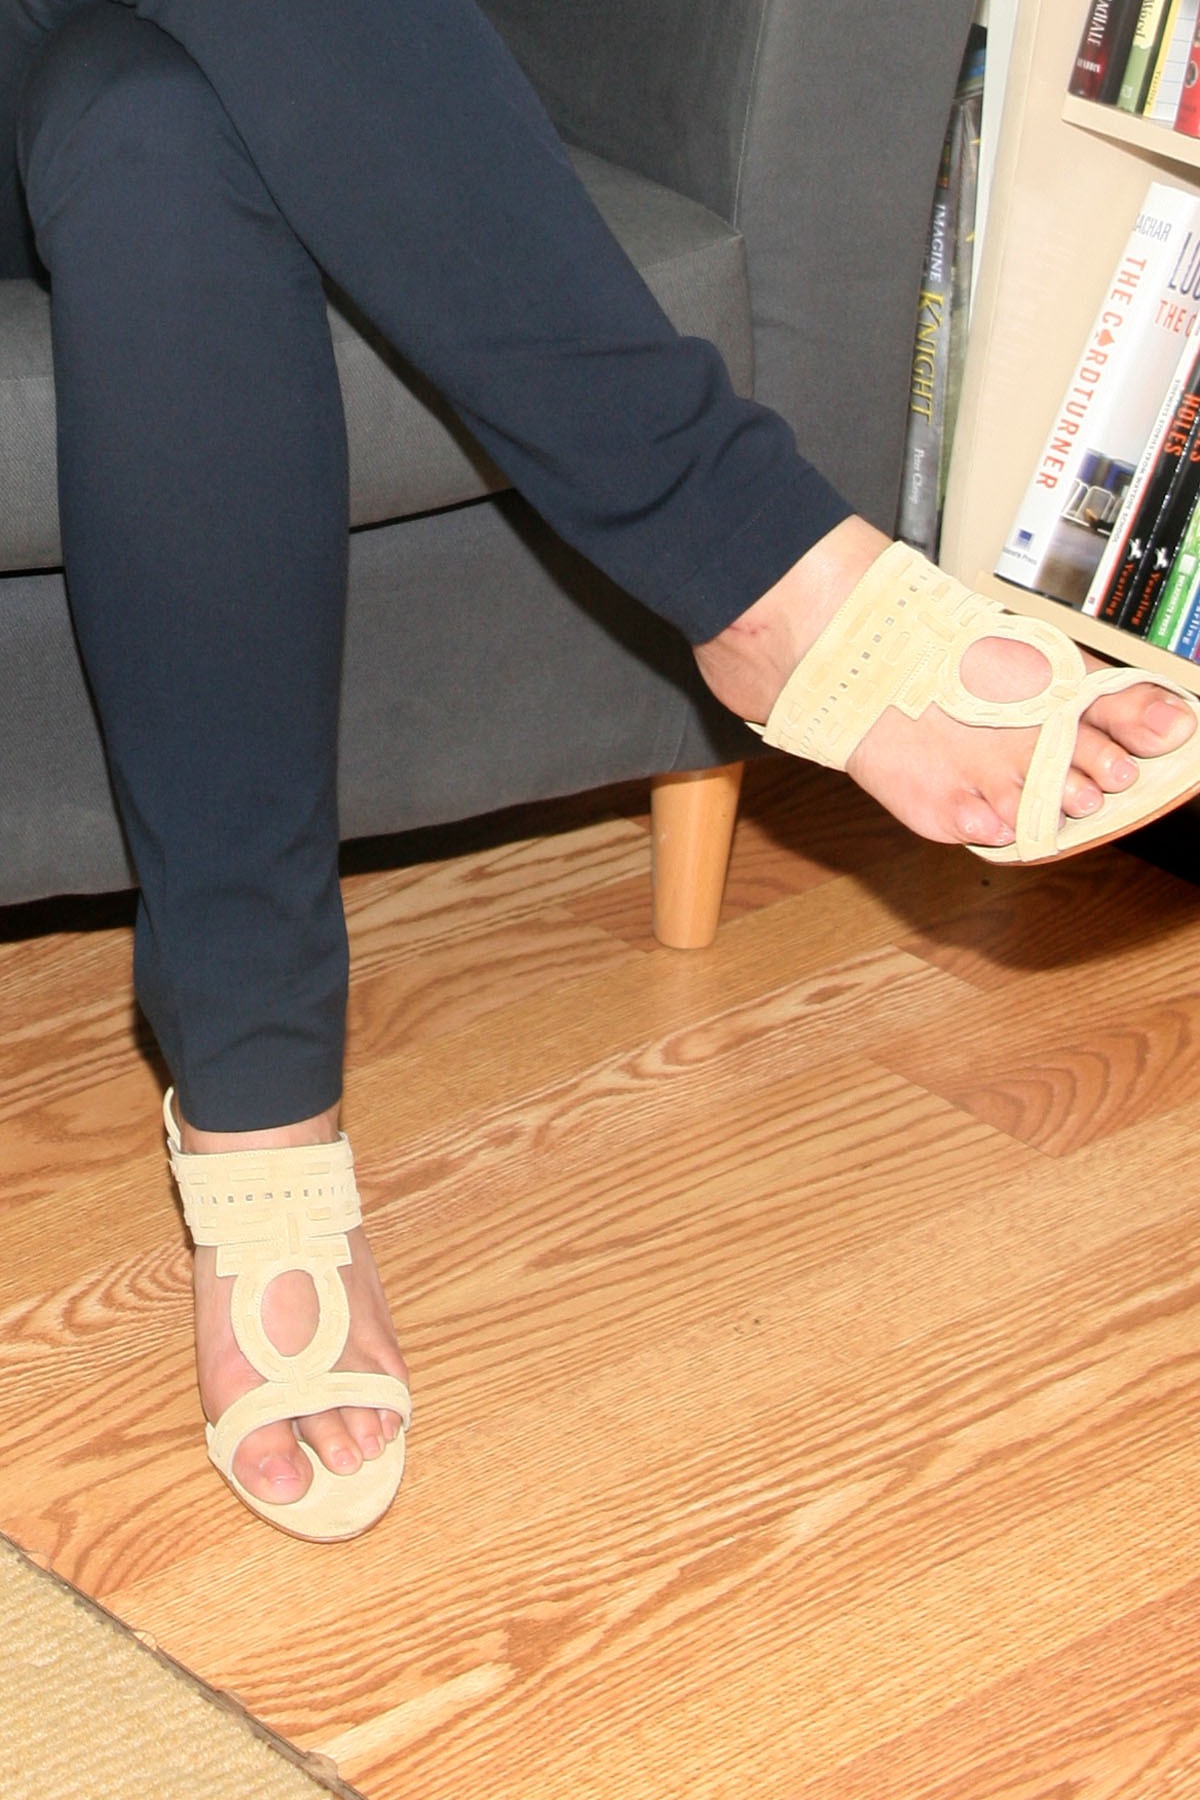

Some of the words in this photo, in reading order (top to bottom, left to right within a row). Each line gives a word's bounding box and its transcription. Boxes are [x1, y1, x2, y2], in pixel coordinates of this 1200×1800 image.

[929, 204, 946, 282] IMAGINE
[1110, 254, 1147, 303] THE
[910, 289, 943, 425] KNIGHT
[1164, 393, 1200, 456] HOLES
